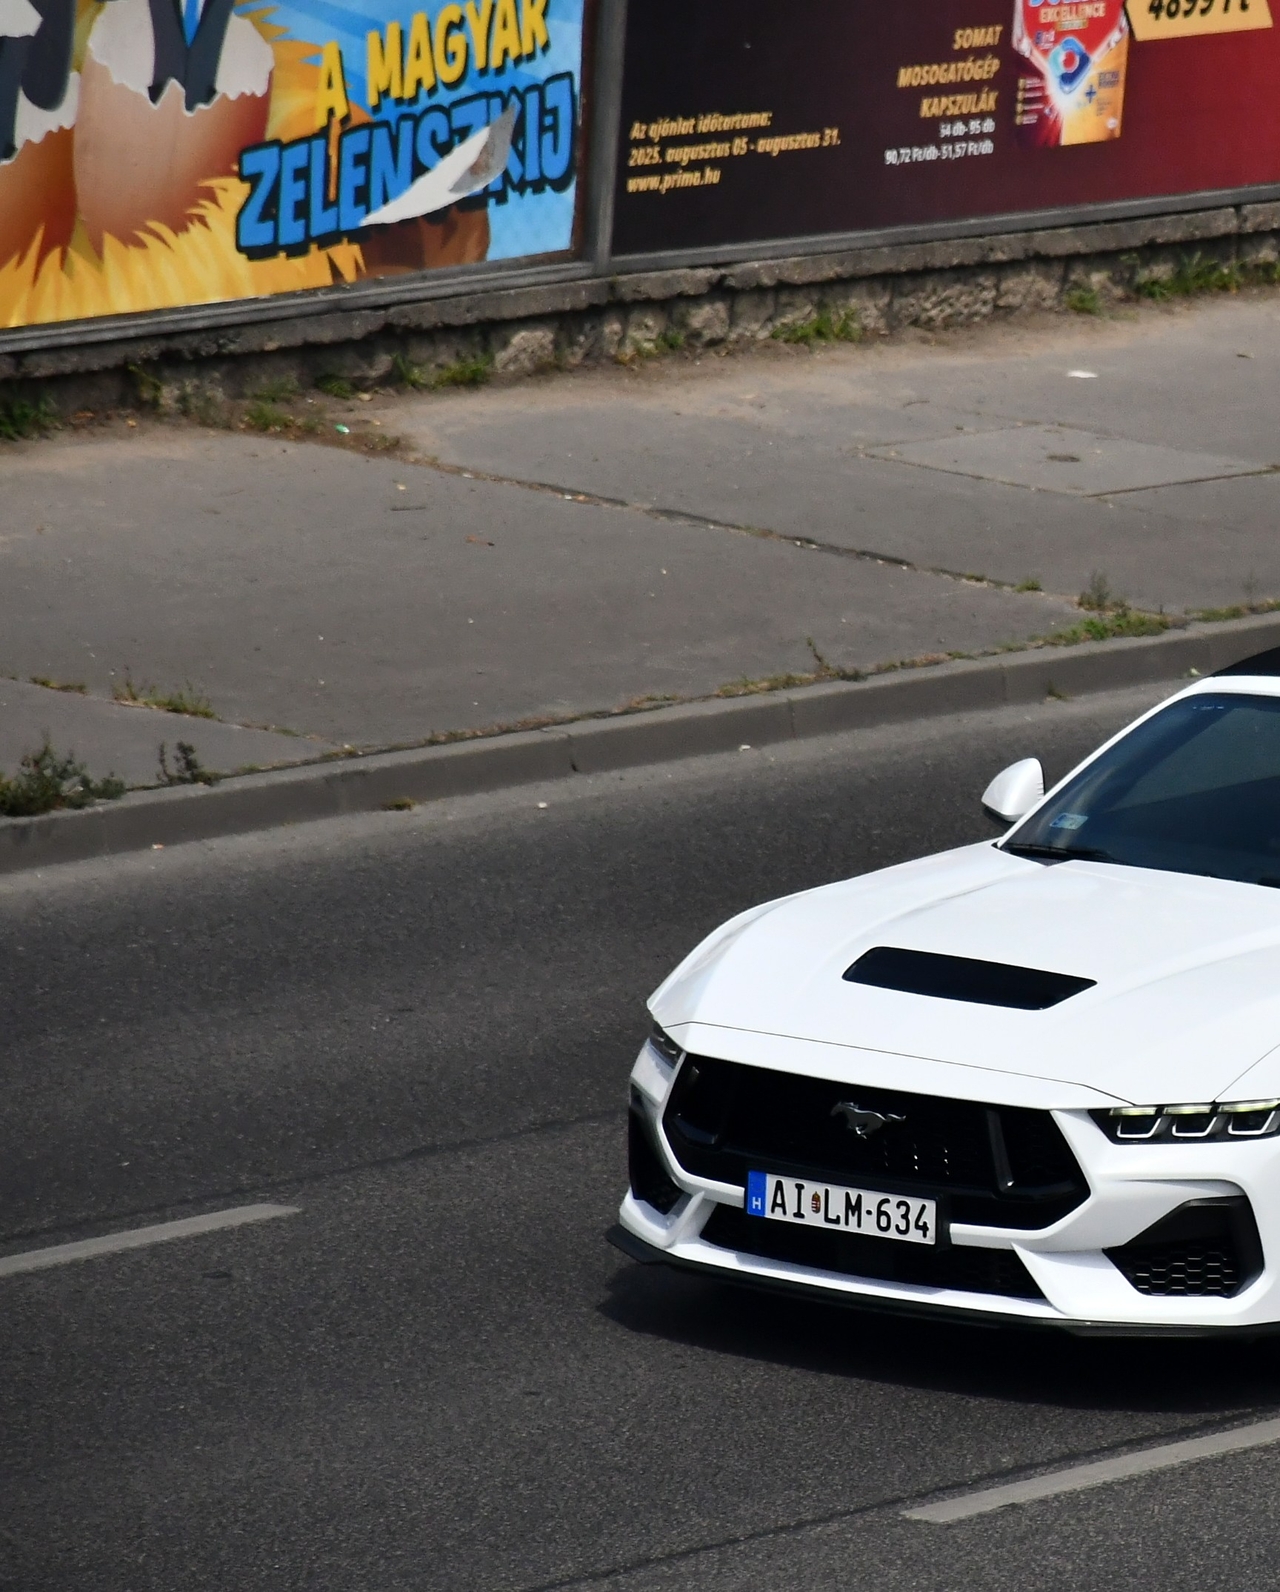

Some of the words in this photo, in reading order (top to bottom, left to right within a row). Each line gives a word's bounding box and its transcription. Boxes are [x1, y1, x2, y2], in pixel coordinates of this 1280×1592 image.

[1039, 3, 1106, 23] EXCELLENCE
[953, 24, 1003, 50] SOMAT
[315, 41, 349, 127] A
[367, 0, 549, 107] MAGYAR
[897, 54, 1000, 88] MOSOGATÓGÉP
[920, 86, 999, 118] KAPSZULÁK
[629, 121, 648, 140] Az
[648, 117, 696, 143] ajánlat
[697, 111, 773, 134] időtartama:
[939, 122, 951, 138] 54
[969, 119, 981, 135] 95
[982, 117, 996, 133] db
[628, 146, 662, 167] 2025.
[665, 141, 731, 166] augusztus
[732, 136, 749, 156] 05
[757, 132, 821, 157] augusztus
[822, 127, 841, 147] 31.
[884, 147, 911, 166] 90,72
[968, 139, 994, 156] Ft/db
[627, 166, 721, 195] www.prima.hu
[752, 1197, 762, 1210] H
[824, 1187, 930, 1239] LM-634
